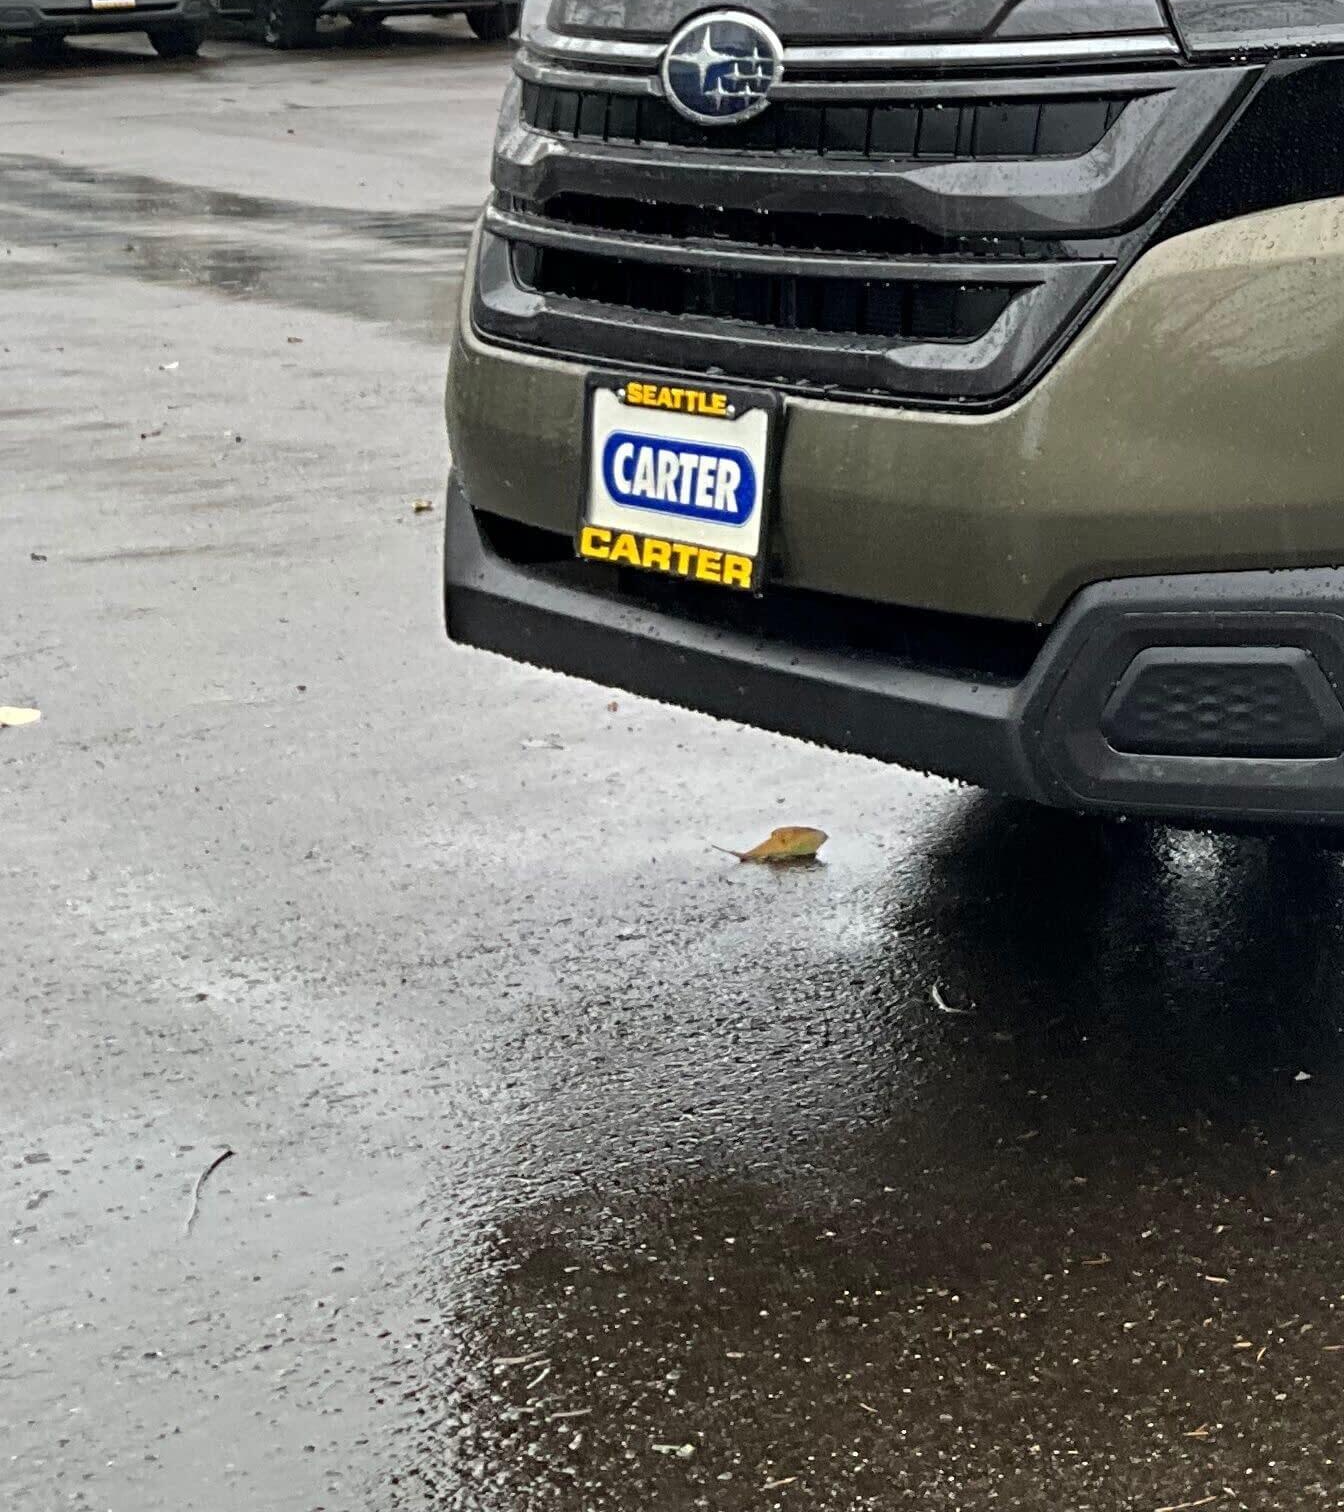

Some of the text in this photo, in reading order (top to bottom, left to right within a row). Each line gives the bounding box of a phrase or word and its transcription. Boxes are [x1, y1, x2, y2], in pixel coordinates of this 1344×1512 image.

[626, 381, 727, 415] SEATTLE
[612, 442, 741, 513] CARTER
[580, 526, 753, 589] CARTER
